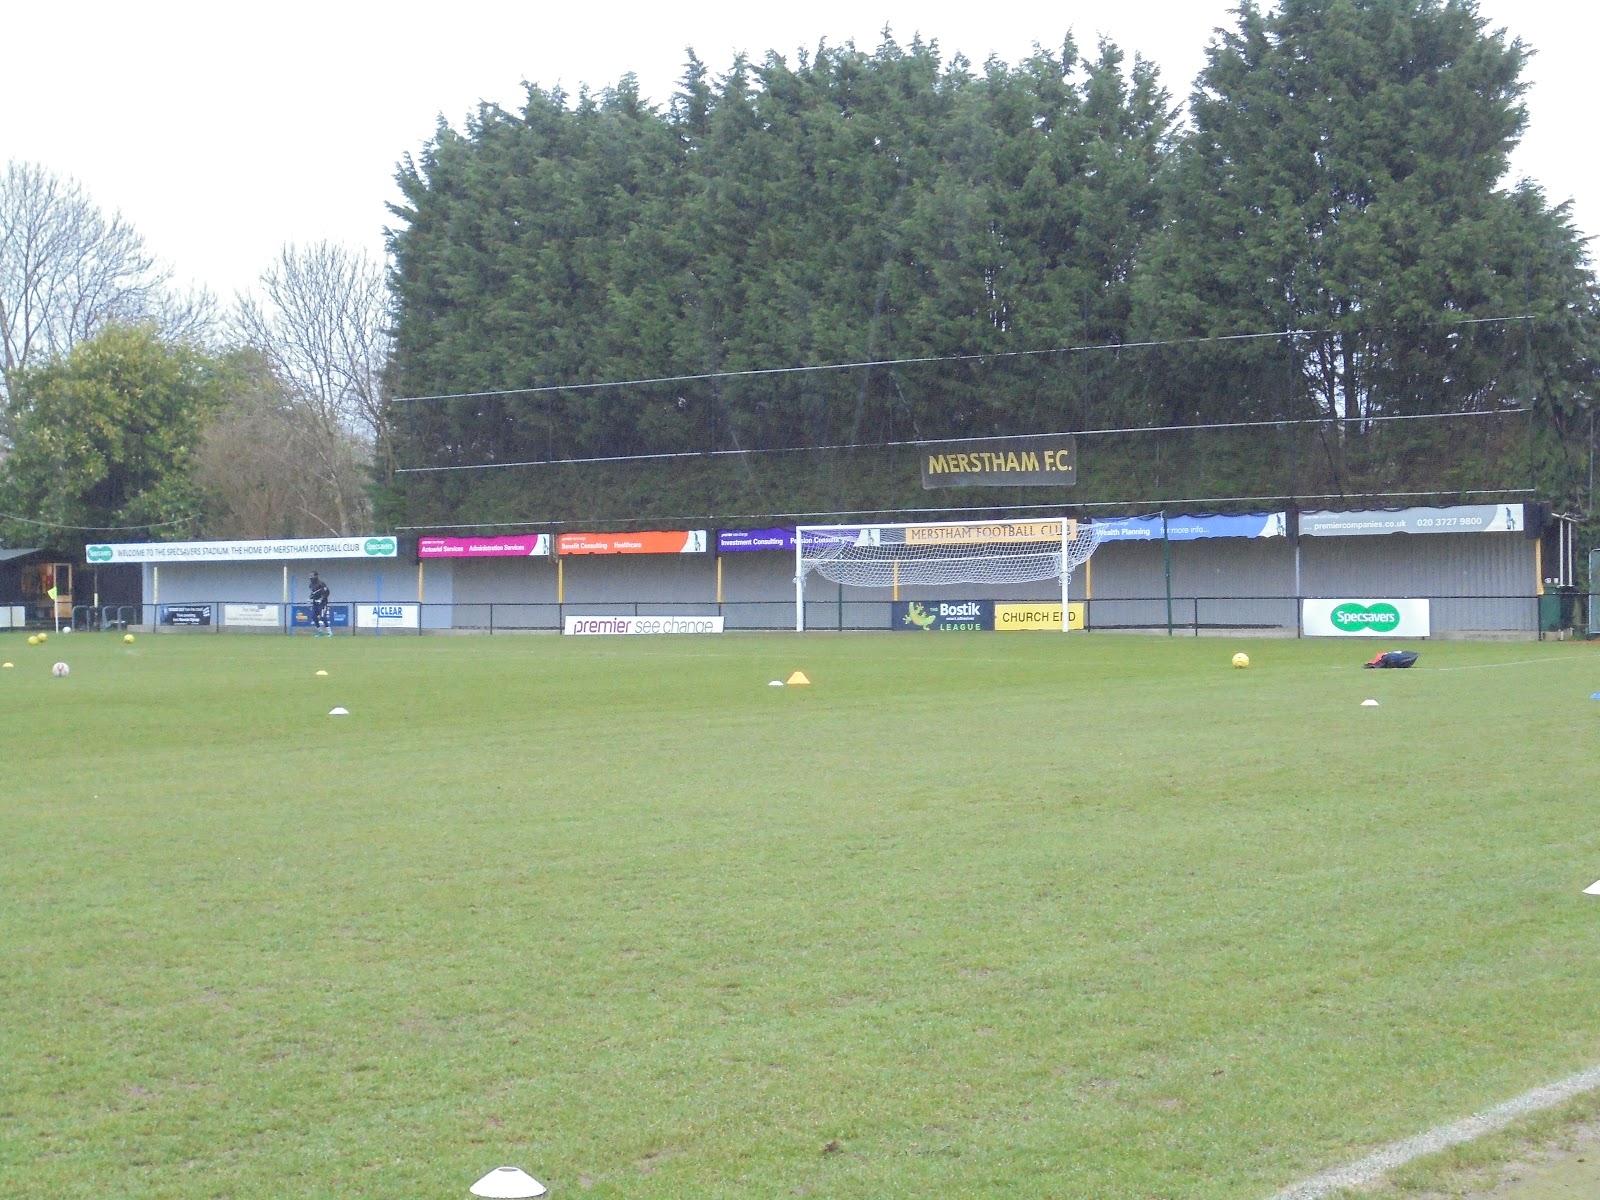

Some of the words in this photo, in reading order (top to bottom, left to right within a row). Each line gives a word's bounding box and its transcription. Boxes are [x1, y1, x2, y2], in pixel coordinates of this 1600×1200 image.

[928, 452, 1039, 475] MERSTHAM
[1044, 450, 1072, 471] F.C.
[1314, 519, 1407, 531] premiercompanies.co.uk
[1417, 518, 1433, 527] 020
[1435, 518, 1457, 526] 3727
[1459, 517, 1482, 526] 9800
[911, 527, 971, 540] MERSTHAM
[976, 525, 1035, 538] FOOTBALL
[1121, 528, 1151, 536] Planning
[1160, 526, 1170, 534] fr
[580, 542, 608, 550] Consulting
[613, 541, 642, 549] Healthcare
[720, 539, 752, 547] Investment
[752, 538, 784, 546] Consulting
[790, 537, 813, 545] Pesion
[117, 548, 145, 557] WELCOME
[155, 547, 166, 556] THE
[166, 547, 201, 556] SPECSAVERS
[231, 546, 243, 554] THE
[243, 546, 262, 554] HOME
[263, 546, 272, 554] OF
[273, 545, 309, 553] MERSTHAM
[310, 544, 341, 553] FOOTBALL
[342, 543, 360, 552] CLUB
[366, 542, 393, 551] Specsavers
[940, 602, 981, 616] Bostik
[1002, 611, 1049, 623] CHURCH
[1336, 610, 1395, 624] Specsavers
[574, 617, 631, 635] premier
[634, 620, 661, 633] see
[663, 617, 713, 633] change
[940, 623, 981, 631] LEAGUE
